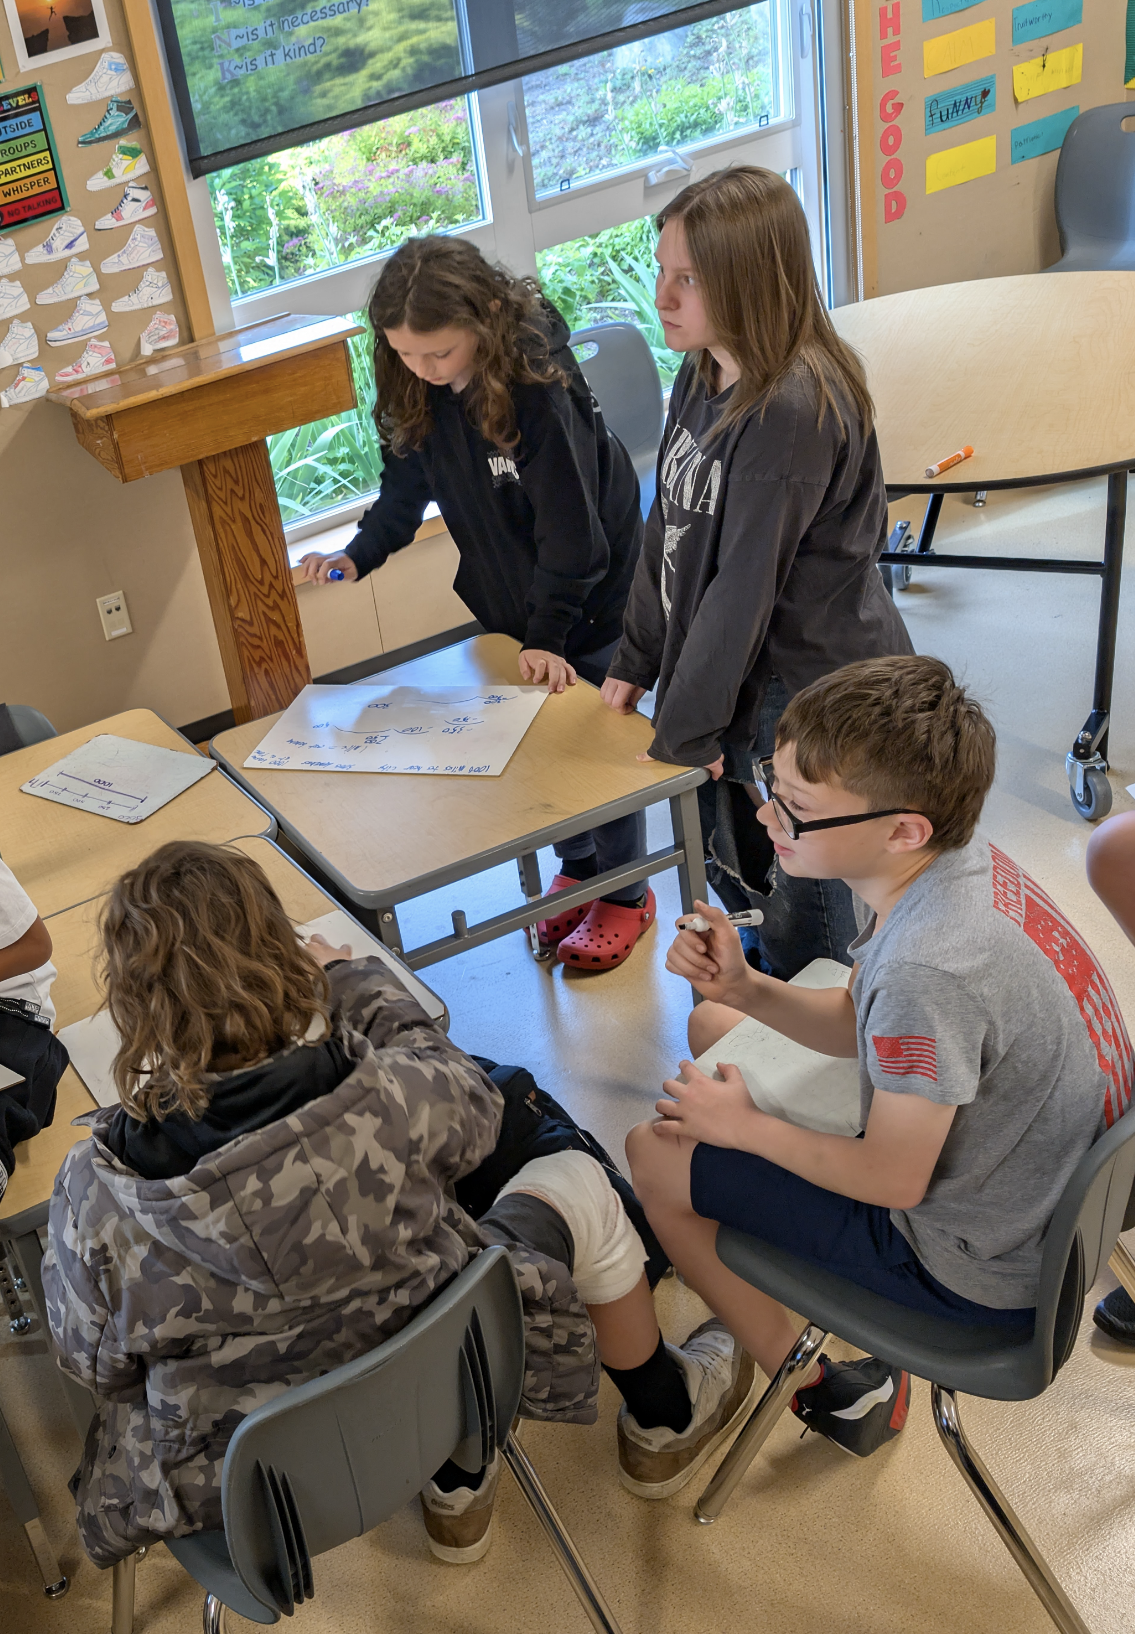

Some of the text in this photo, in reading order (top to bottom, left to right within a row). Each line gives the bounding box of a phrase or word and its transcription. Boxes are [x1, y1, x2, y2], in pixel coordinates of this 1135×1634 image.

[264, 20, 277, 36] it
[264, 50, 277, 67] it
[282, 35, 326, 62] kind?
[2, 176, 51, 199] WHISPER
[7, 207, 21, 218] NO
[22, 195, 57, 214] TALKING
